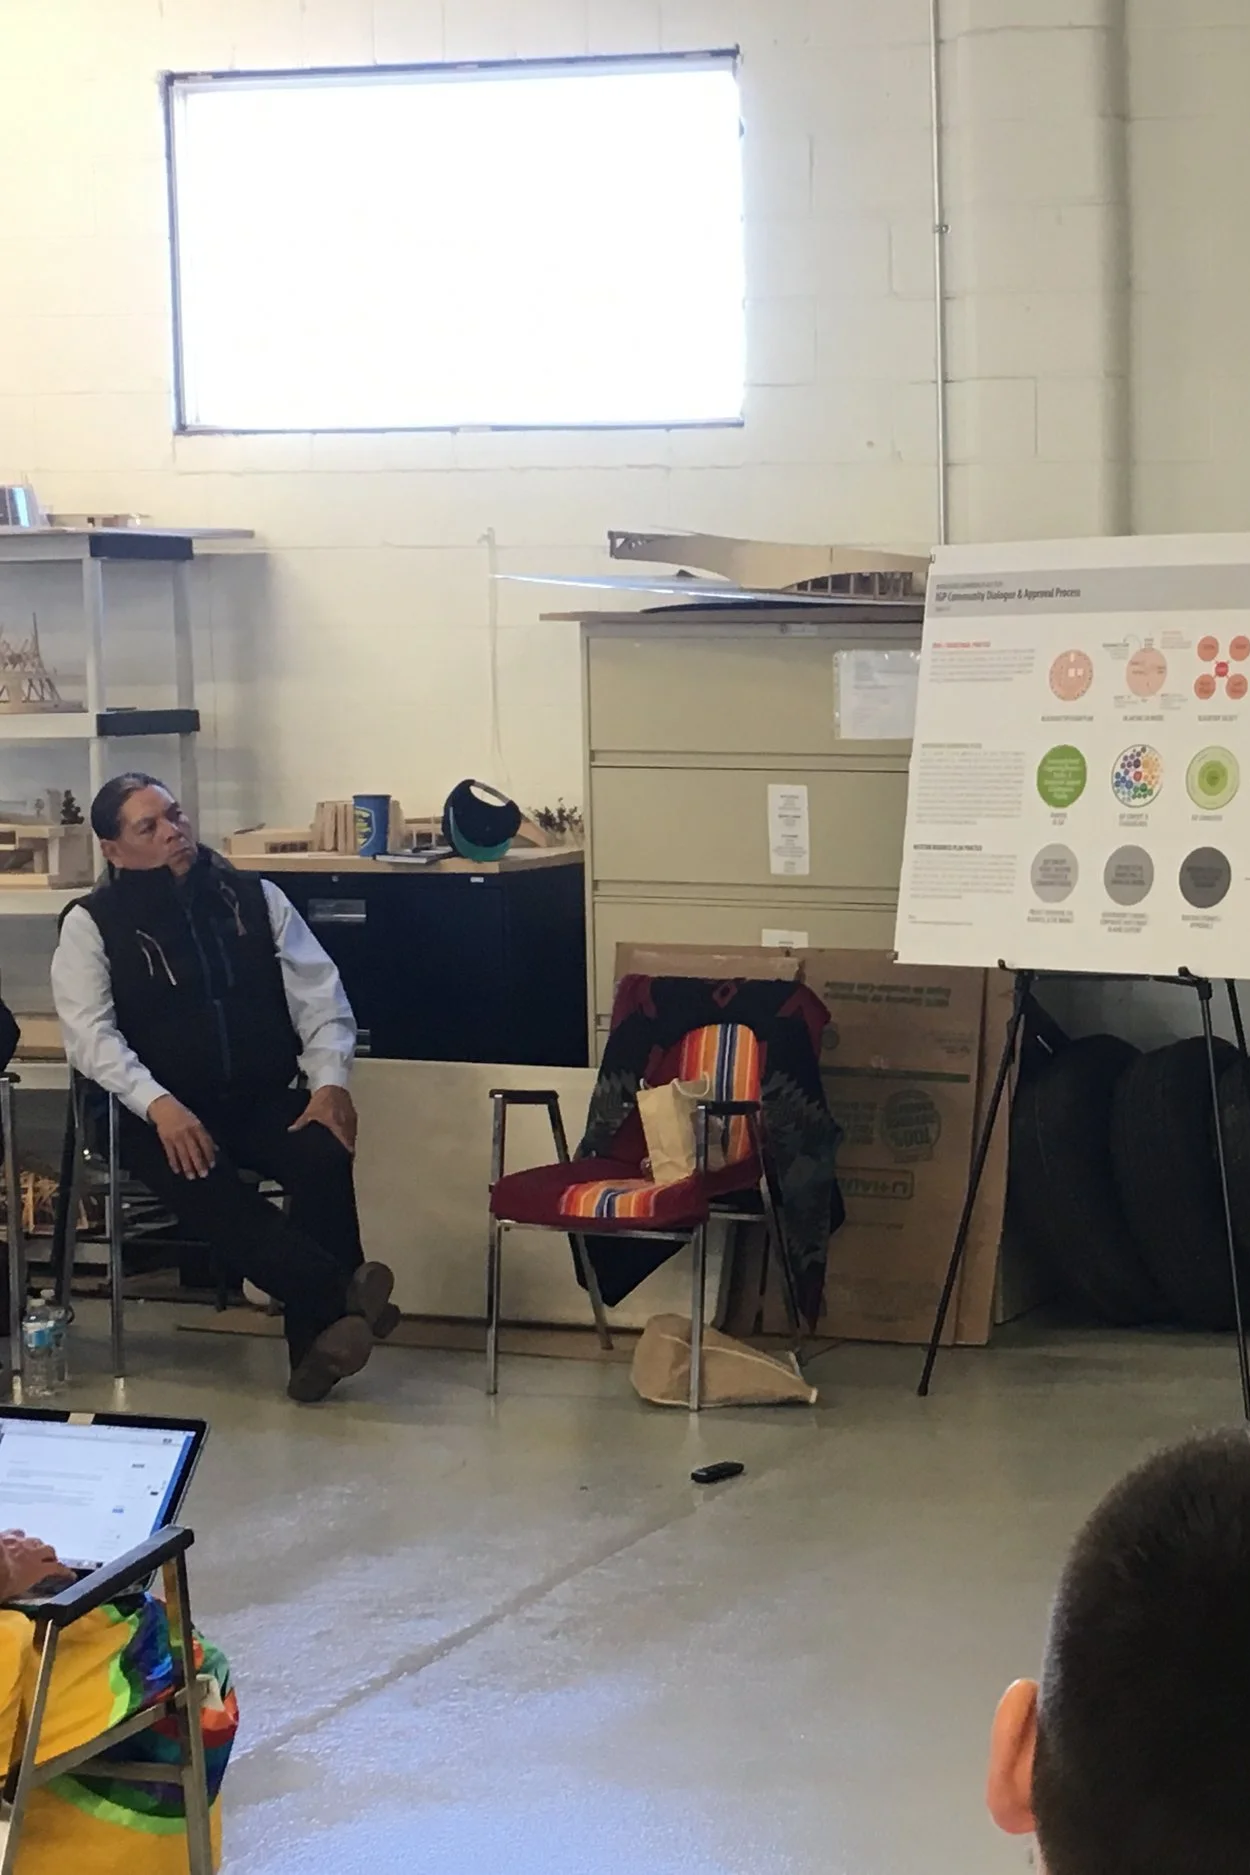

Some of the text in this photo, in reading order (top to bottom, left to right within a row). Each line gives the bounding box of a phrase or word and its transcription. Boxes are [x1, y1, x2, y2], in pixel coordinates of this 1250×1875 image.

[1017, 588, 1023, 599] &
[1024, 588, 1054, 600] Approval
[1055, 587, 1081, 598] Process
